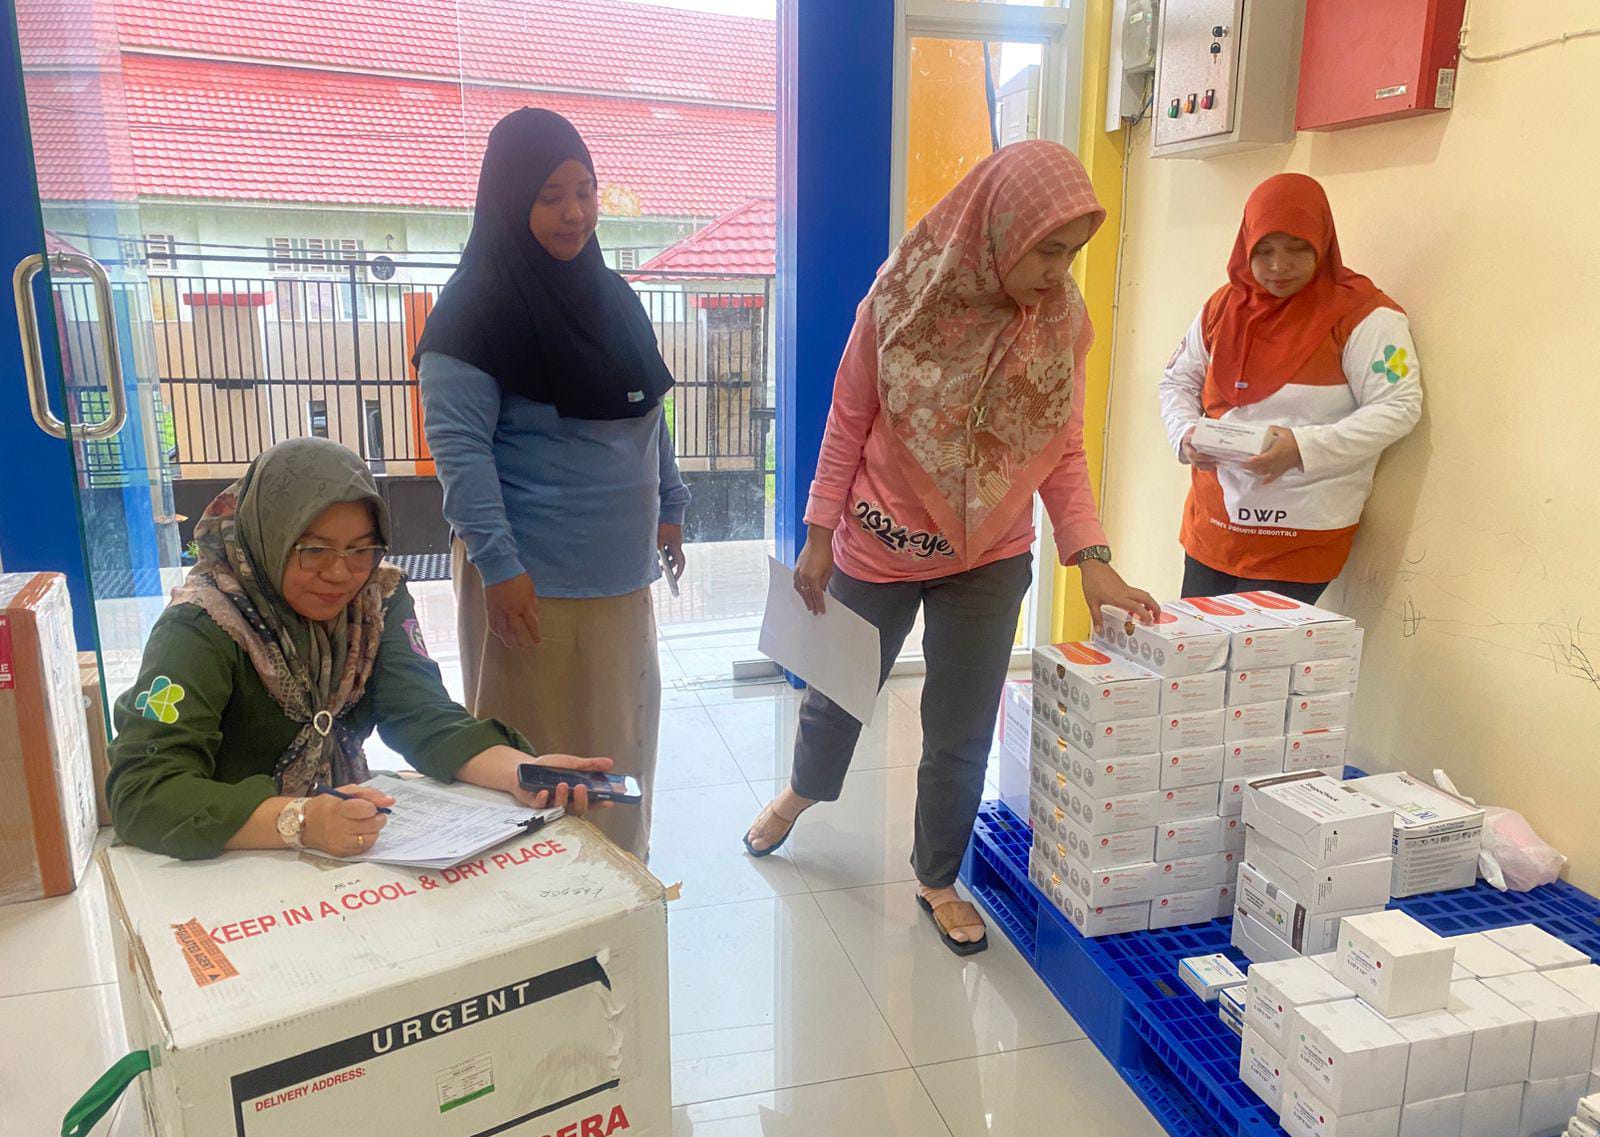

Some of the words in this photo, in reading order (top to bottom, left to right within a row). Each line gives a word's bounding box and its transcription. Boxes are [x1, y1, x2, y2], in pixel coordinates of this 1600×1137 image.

[1238, 508, 1287, 523] DWP
[1258, 529, 1297, 537] GORONTALO
[208, 914, 277, 945] KEEP
[281, 905, 314, 927] IN
[319, 900, 341, 918] A
[341, 881, 417, 911] COOL
[418, 875, 440, 892] &
[439, 859, 489, 885] DRY
[490, 839, 568, 870] PLACE
[193, 951, 215, 972] AGENT
[371, 981, 532, 1054] URGENT
[254, 1086, 309, 1112] DELIVERY
[311, 1067, 366, 1094] ADDRESS:
[541, 1104, 630, 1137] ERA
